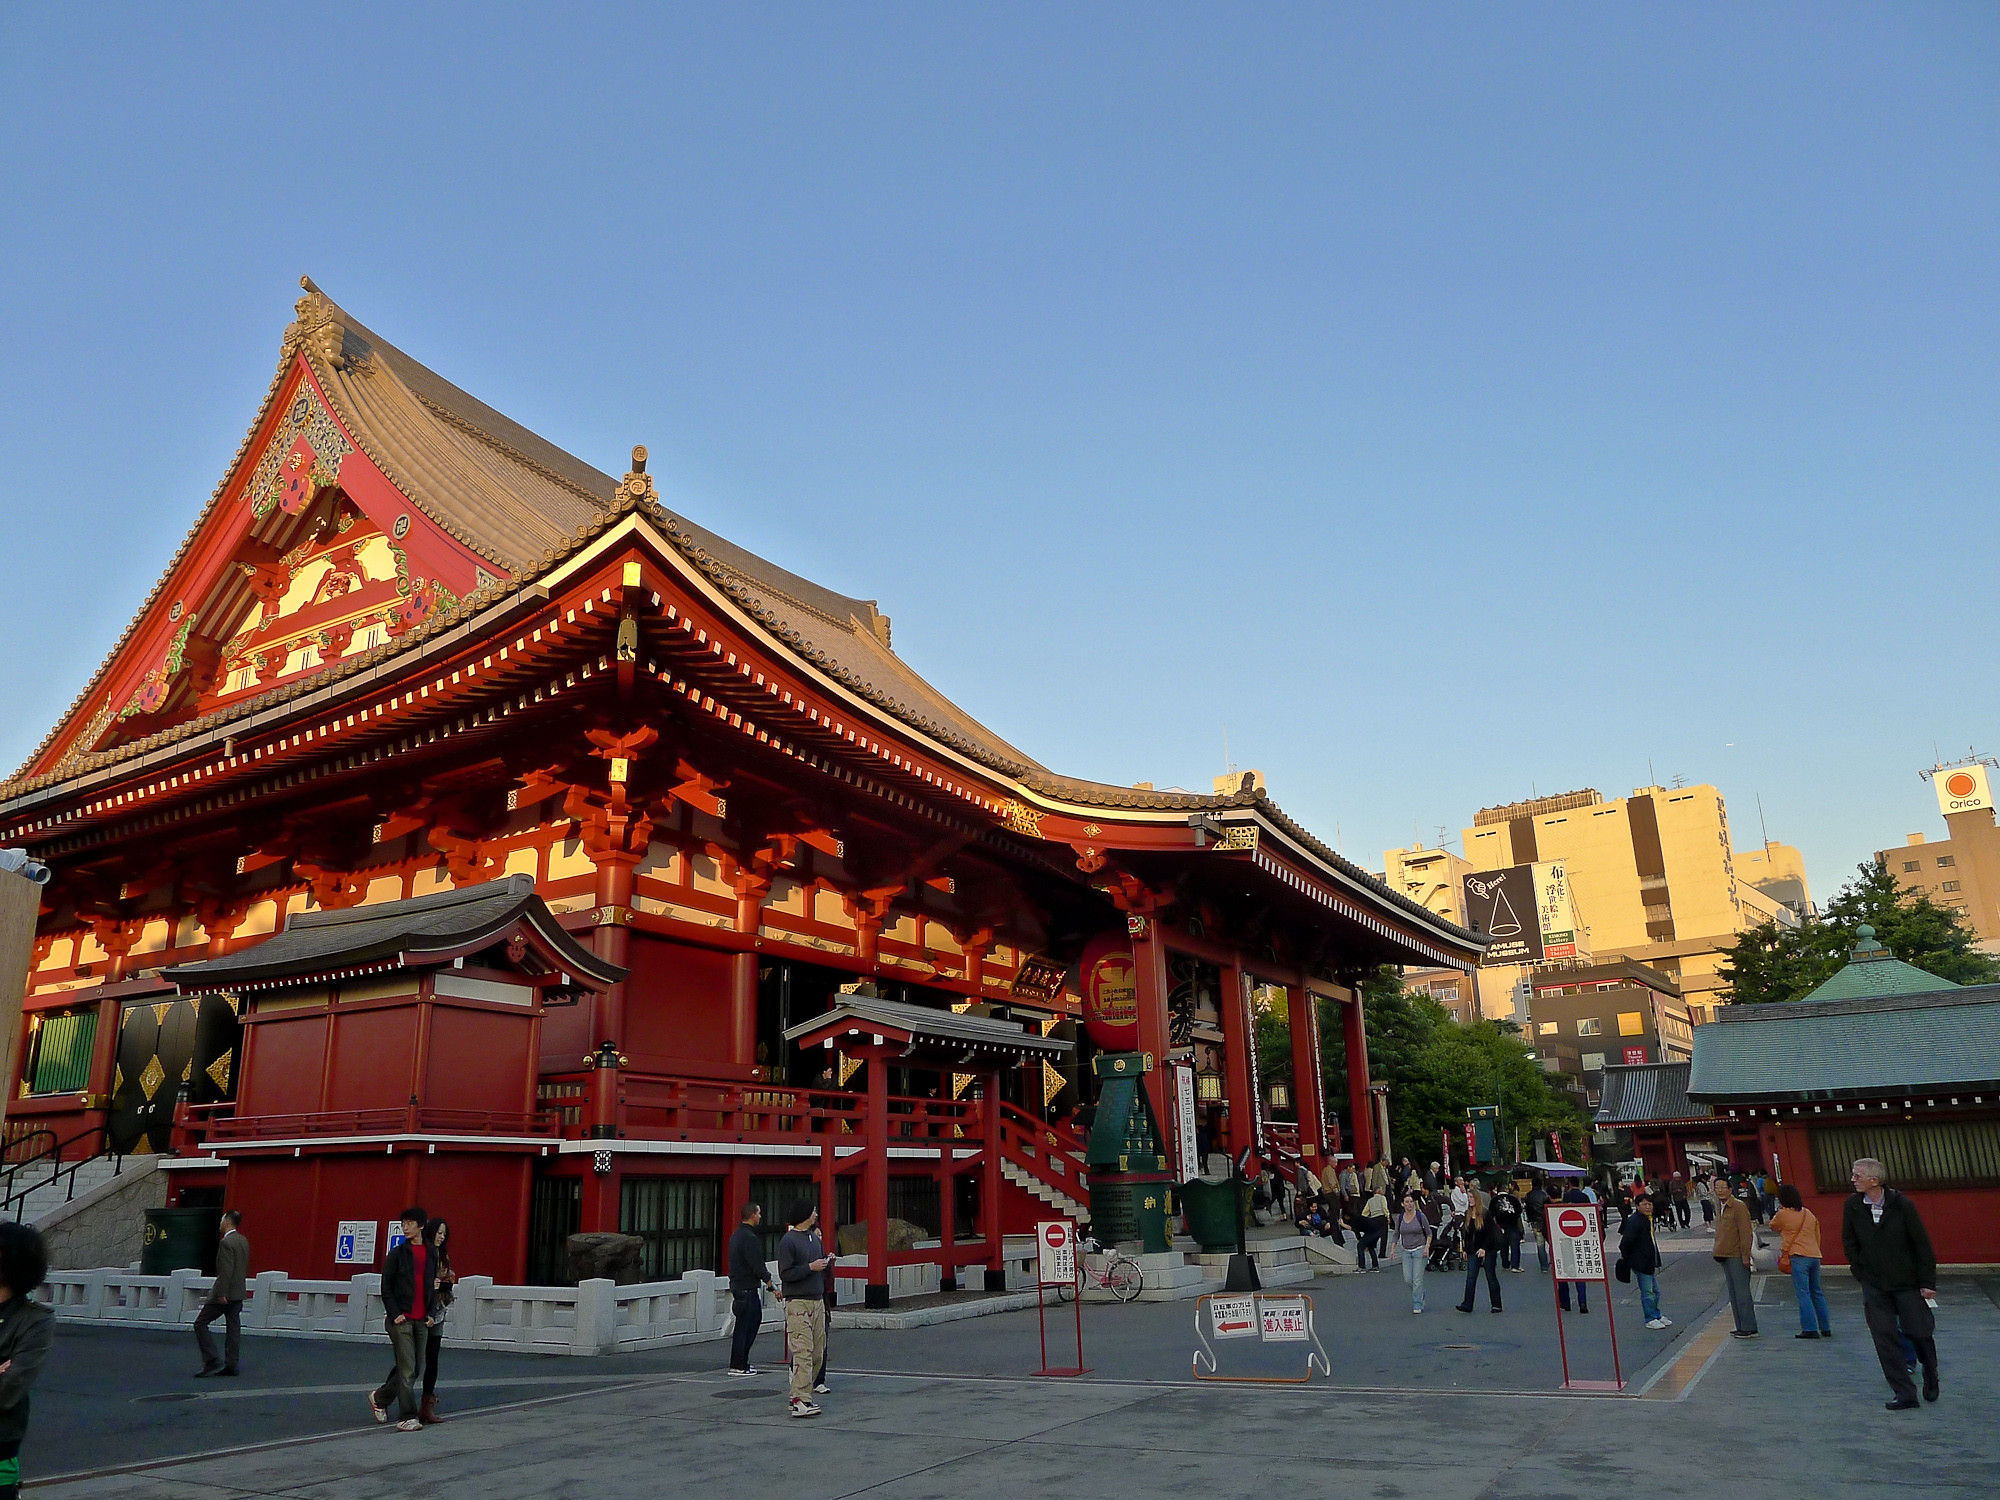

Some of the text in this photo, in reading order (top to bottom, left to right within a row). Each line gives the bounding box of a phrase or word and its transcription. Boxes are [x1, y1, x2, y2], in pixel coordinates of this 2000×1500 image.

[1949, 798, 1981, 809] Orico
[1486, 873, 1507, 890] Here!
[1490, 940, 1526, 951] AMUSE
[1487, 947, 1530, 959] MUSEUM
[1575, 1240, 1585, 1274] 出来ません
[1213, 1301, 1251, 1311] 自転車の方は
[1264, 1317, 1304, 1332] 進入禁止
